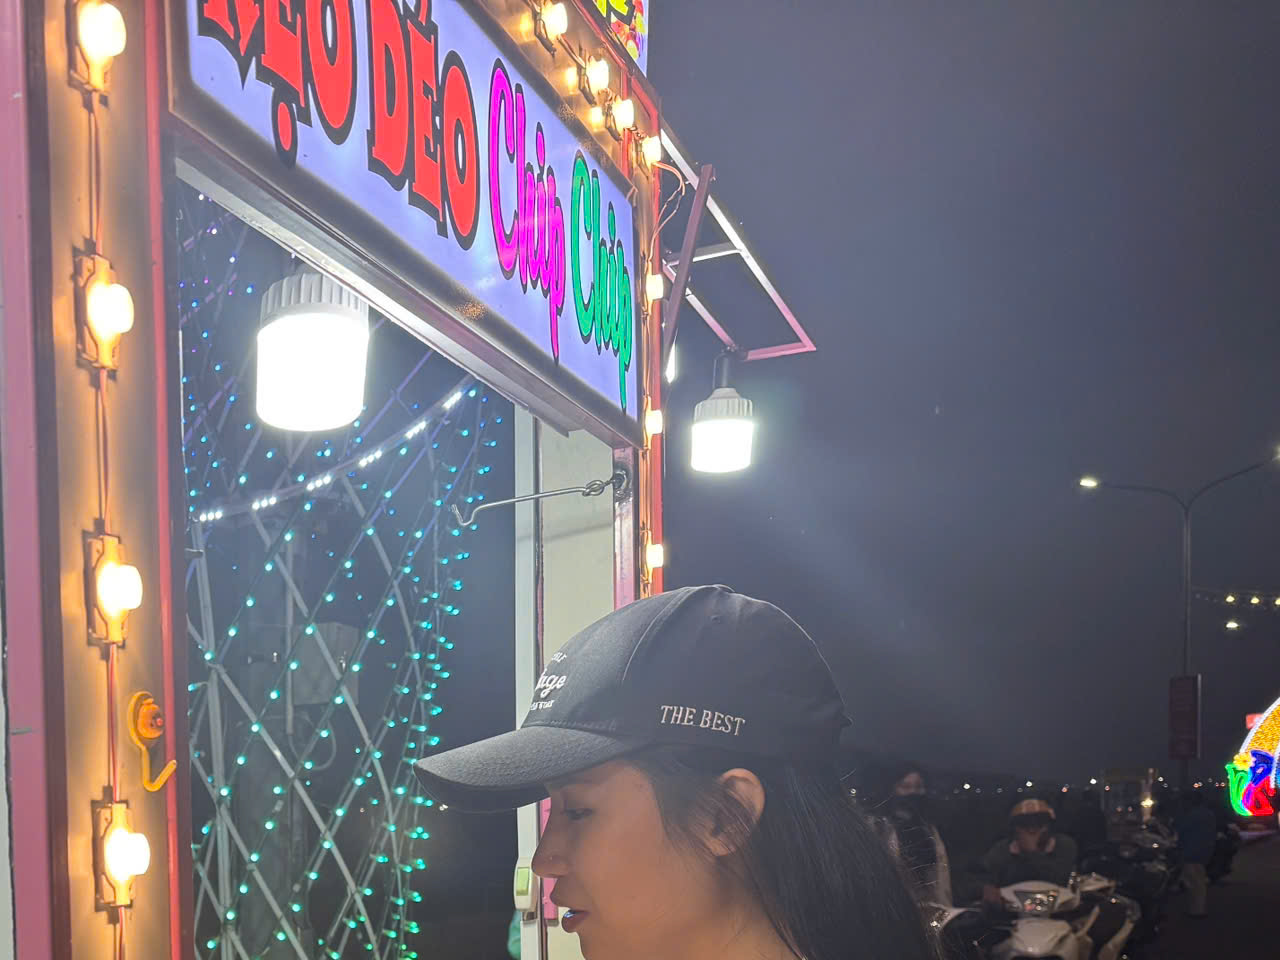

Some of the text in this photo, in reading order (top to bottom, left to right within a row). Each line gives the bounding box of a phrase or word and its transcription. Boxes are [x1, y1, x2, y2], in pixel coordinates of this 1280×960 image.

[198, 0, 357, 166] ẸO
[488, 57, 565, 364] Chip
[571, 149, 632, 413] Chip
[660, 704, 746, 736] THE BEST
